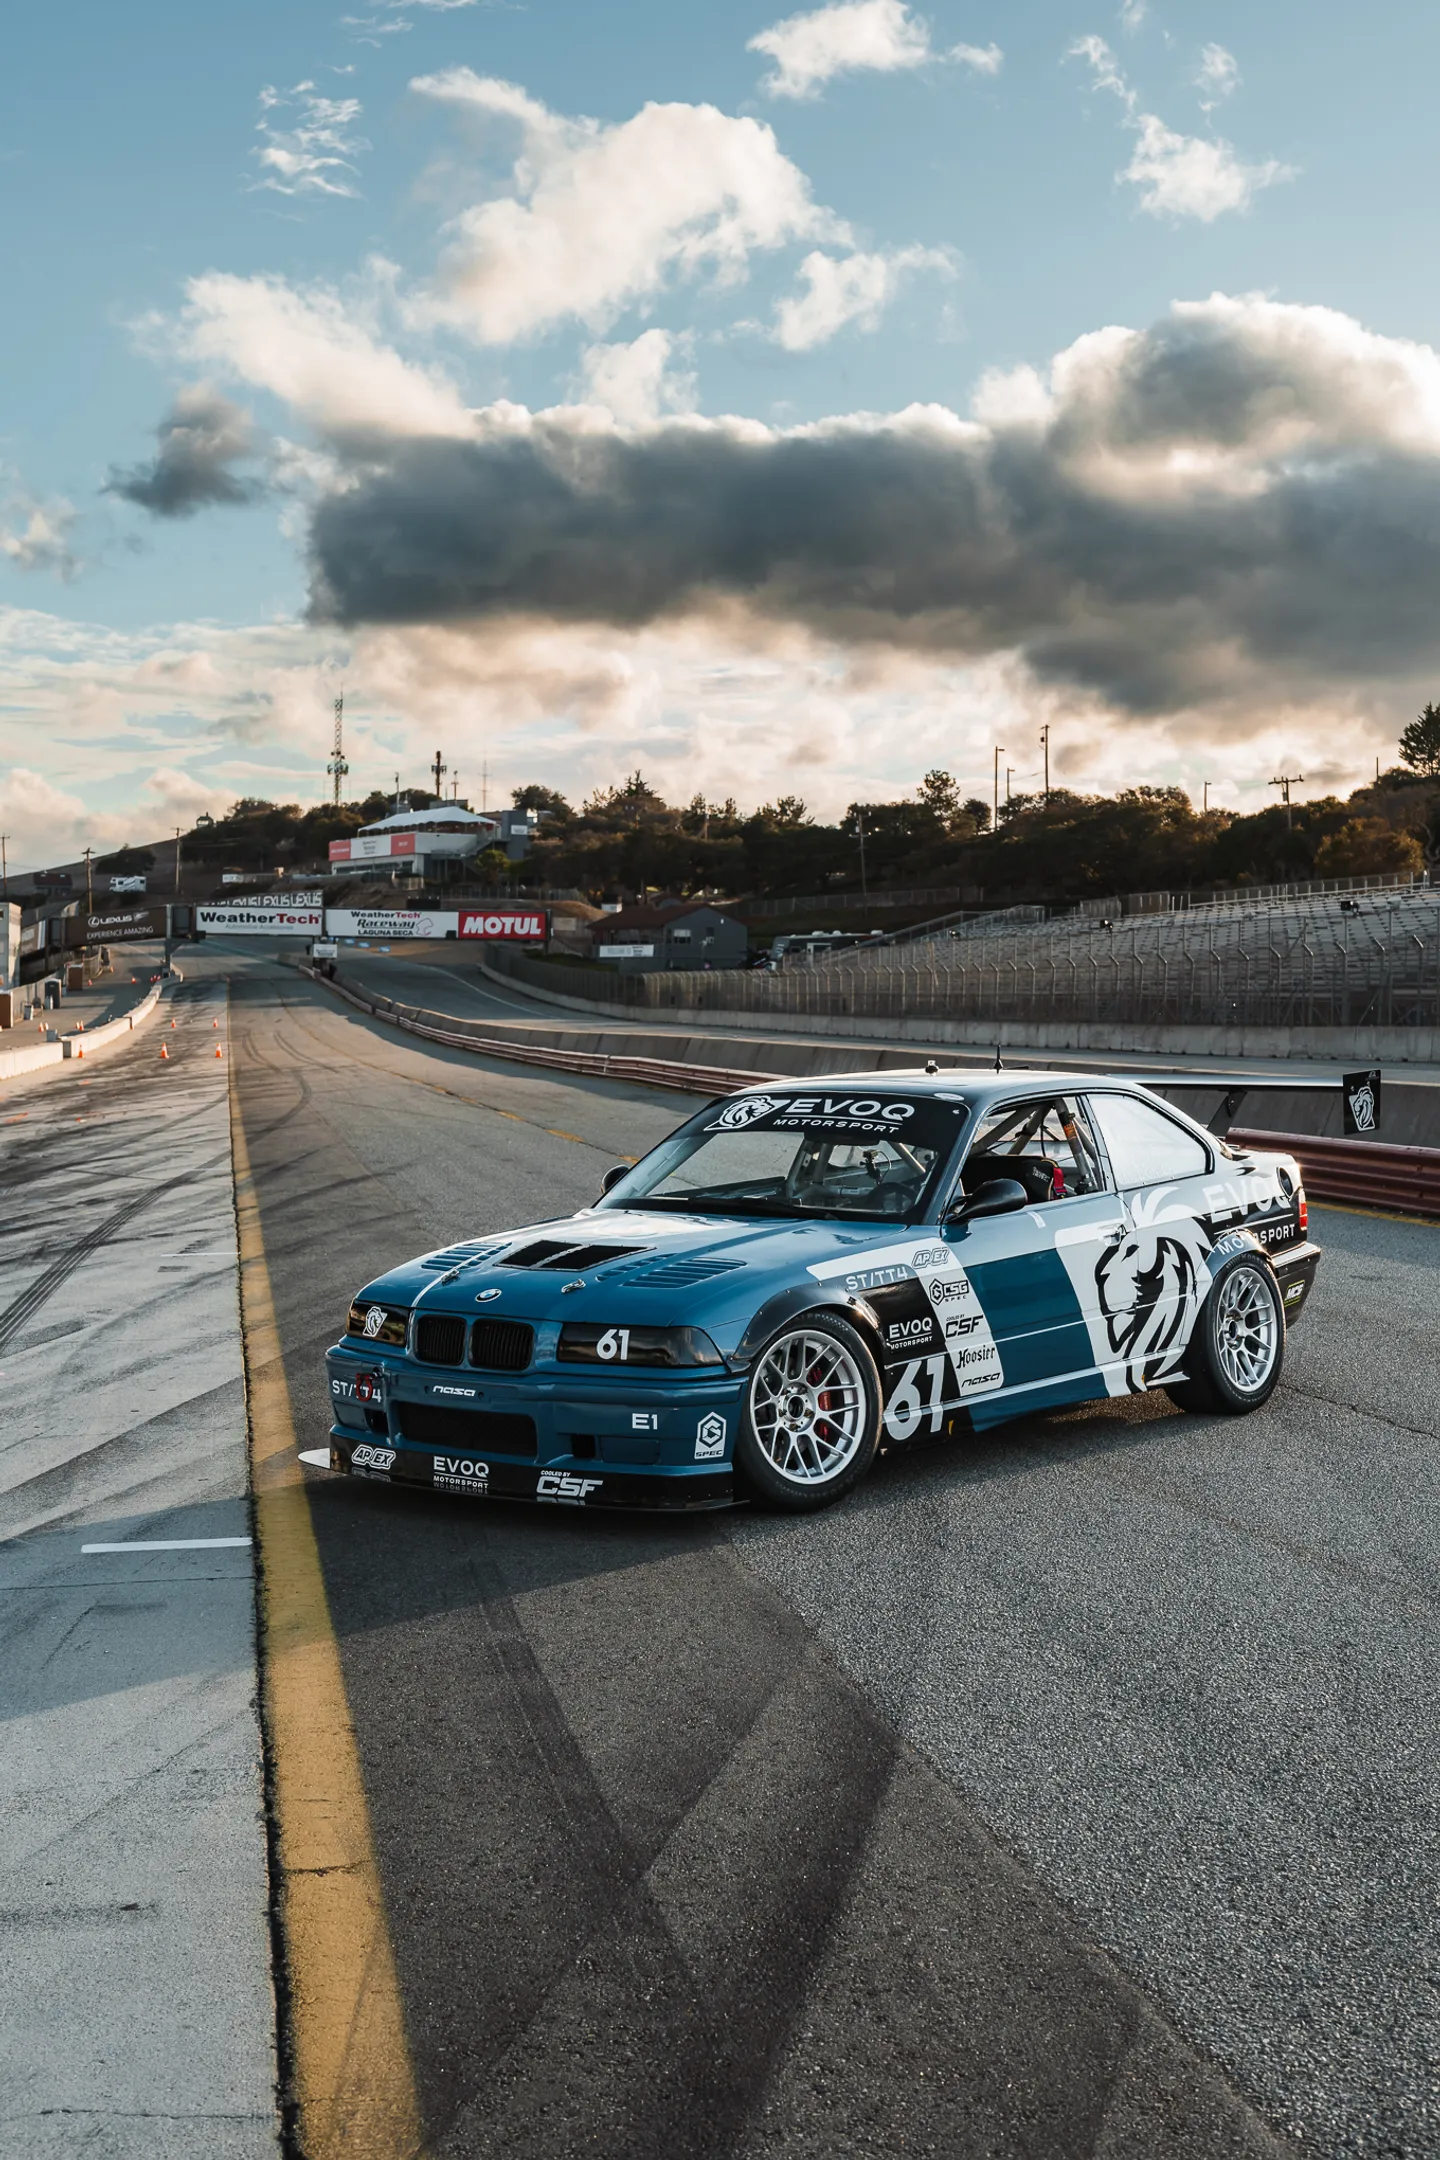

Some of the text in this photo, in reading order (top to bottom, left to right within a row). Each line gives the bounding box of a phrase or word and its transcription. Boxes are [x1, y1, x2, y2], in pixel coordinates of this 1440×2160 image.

[290, 892, 322, 908] LEXUS
[100, 914, 133, 925] LEXUS
[200, 912, 320, 924] WeatherTech
[351, 910, 421, 919] WeatherTech
[357, 918, 415, 929] Raceway
[463, 917, 542, 935] MOTUL
[86, 925, 154, 940] EXPERIENCE AMAZING
[785, 1098, 915, 1121] EVOQ
[773, 1118, 900, 1134] MOTORSPORT
[914, 1249, 947, 1267] APEX
[845, 1266, 909, 1290] ST/TT4
[943, 1281, 968, 1296] CSG
[889, 1317, 933, 1338] EVOQ
[945, 1314, 984, 1339] CSF
[596, 1328, 630, 1361] 61
[890, 1335, 933, 1350] MOTORSPORT
[956, 1347, 996, 1369] Hoosier
[883, 1355, 945, 1441] 61
[631, 1413, 658, 1430] E1
[354, 1447, 393, 1467] APEX
[695, 1449, 723, 1458] SPEC
[433, 1455, 490, 1478] EVOQ
[540, 1469, 563, 1477] COOLED
[433, 1475, 489, 1489] MOTORSPORT
[536, 1475, 604, 1498] CSF
